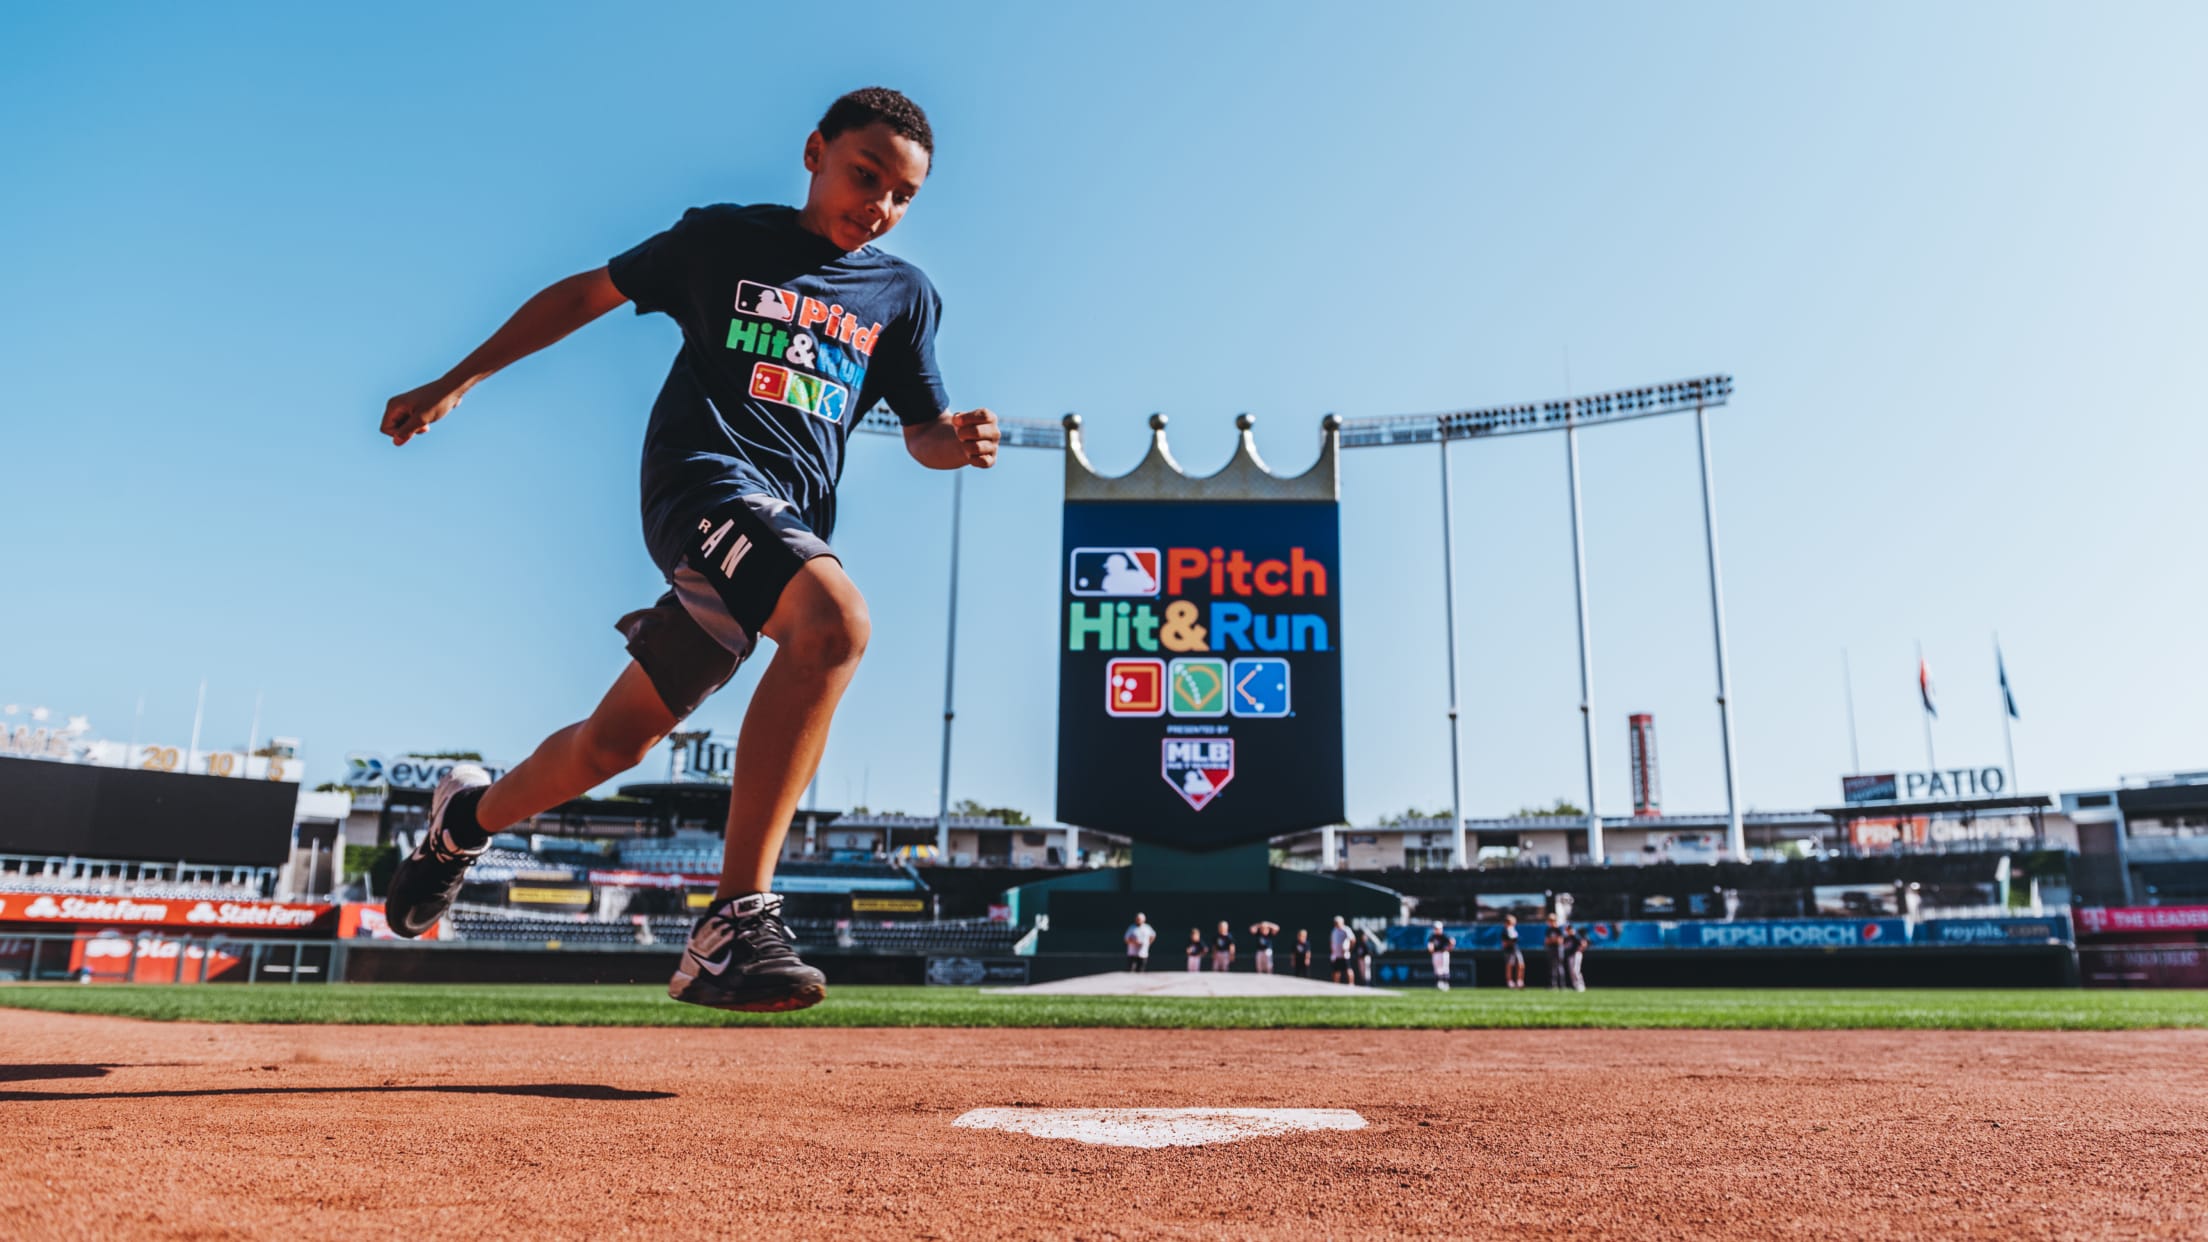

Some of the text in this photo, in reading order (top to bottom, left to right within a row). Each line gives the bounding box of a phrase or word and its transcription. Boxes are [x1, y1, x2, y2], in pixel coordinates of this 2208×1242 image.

[1167, 547, 1327, 596] Pitch
[1217, 725, 1229, 734] BY
[1167, 743, 1229, 762] MLB
[143, 747, 285, 782] 20 10 5
[1906, 767, 2005, 798] PATIO
[2114, 911, 2144, 928] THE
[1702, 925, 1857, 945] PEPSI PORCH
[1943, 922, 2051, 941] royals.com
